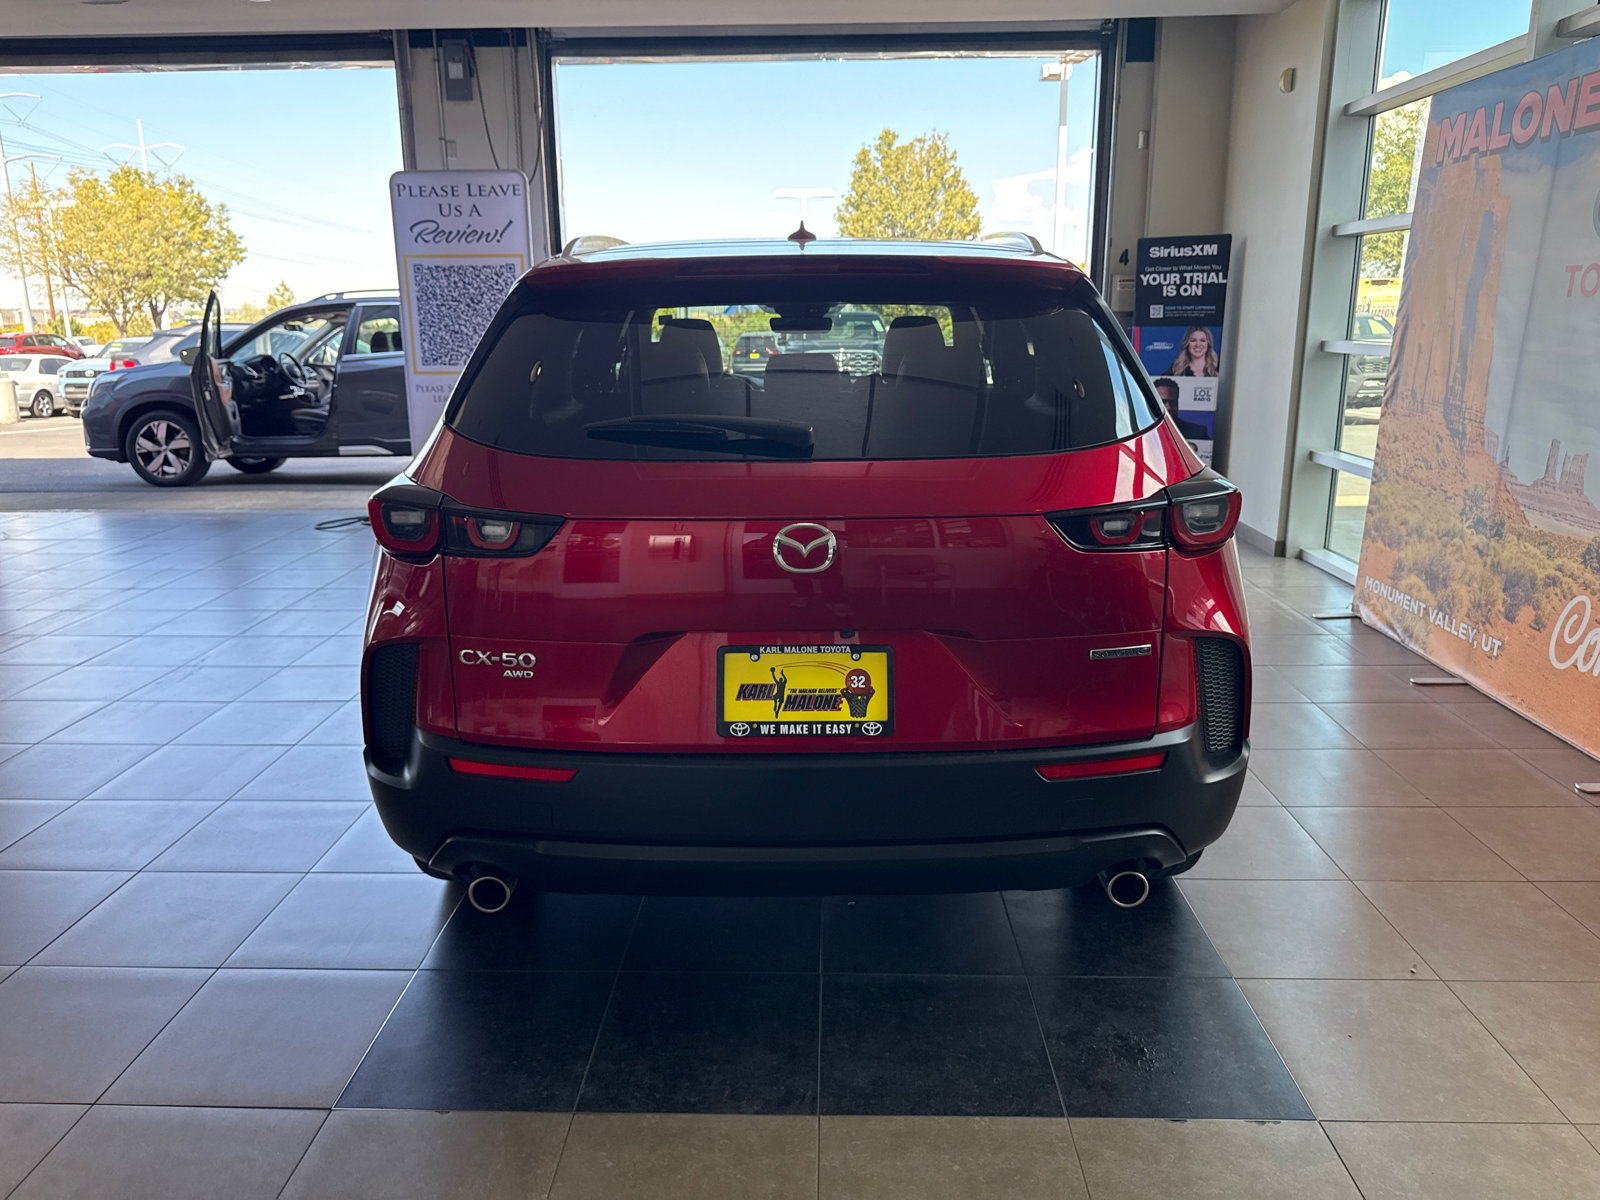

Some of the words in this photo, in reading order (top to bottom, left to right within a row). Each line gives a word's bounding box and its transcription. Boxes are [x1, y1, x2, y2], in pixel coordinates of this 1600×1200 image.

[1436, 70, 1600, 168] MALONE
[396, 183, 460, 198] PLEASE
[466, 183, 521, 197] LEAVE
[438, 203, 463, 217] US
[468, 203, 482, 217] A
[409, 219, 514, 244] Review!
[1119, 248, 1129, 266] 4
[1149, 244, 1218, 258] SiriusXM
[1139, 273, 1181, 286] YOUR
[1183, 272, 1227, 284] TRIAL
[1565, 262, 1600, 298] TO
[1162, 285, 1177, 297] IS
[1179, 284, 1203, 296] ON
[415, 384, 445, 393] PLEASE
[1194, 389, 1211, 397] LOL
[1364, 575, 1428, 618] MONUMENT
[1428, 606, 1479, 650] VALLEY,
[1480, 633, 1503, 657] UT
[759, 646, 782, 654] KARL
[784, 646, 818, 654] MALONE
[458, 649, 537, 668] CX-50
[502, 669, 534, 678] AWD
[850, 675, 866, 688] 32
[735, 683, 777, 701] KARL
[782, 694, 843, 712] MALONE
[760, 724, 776, 735] WE
[780, 724, 809, 735] MAKE
[812, 724, 822, 735] IT
[825, 723, 852, 735] EASY
